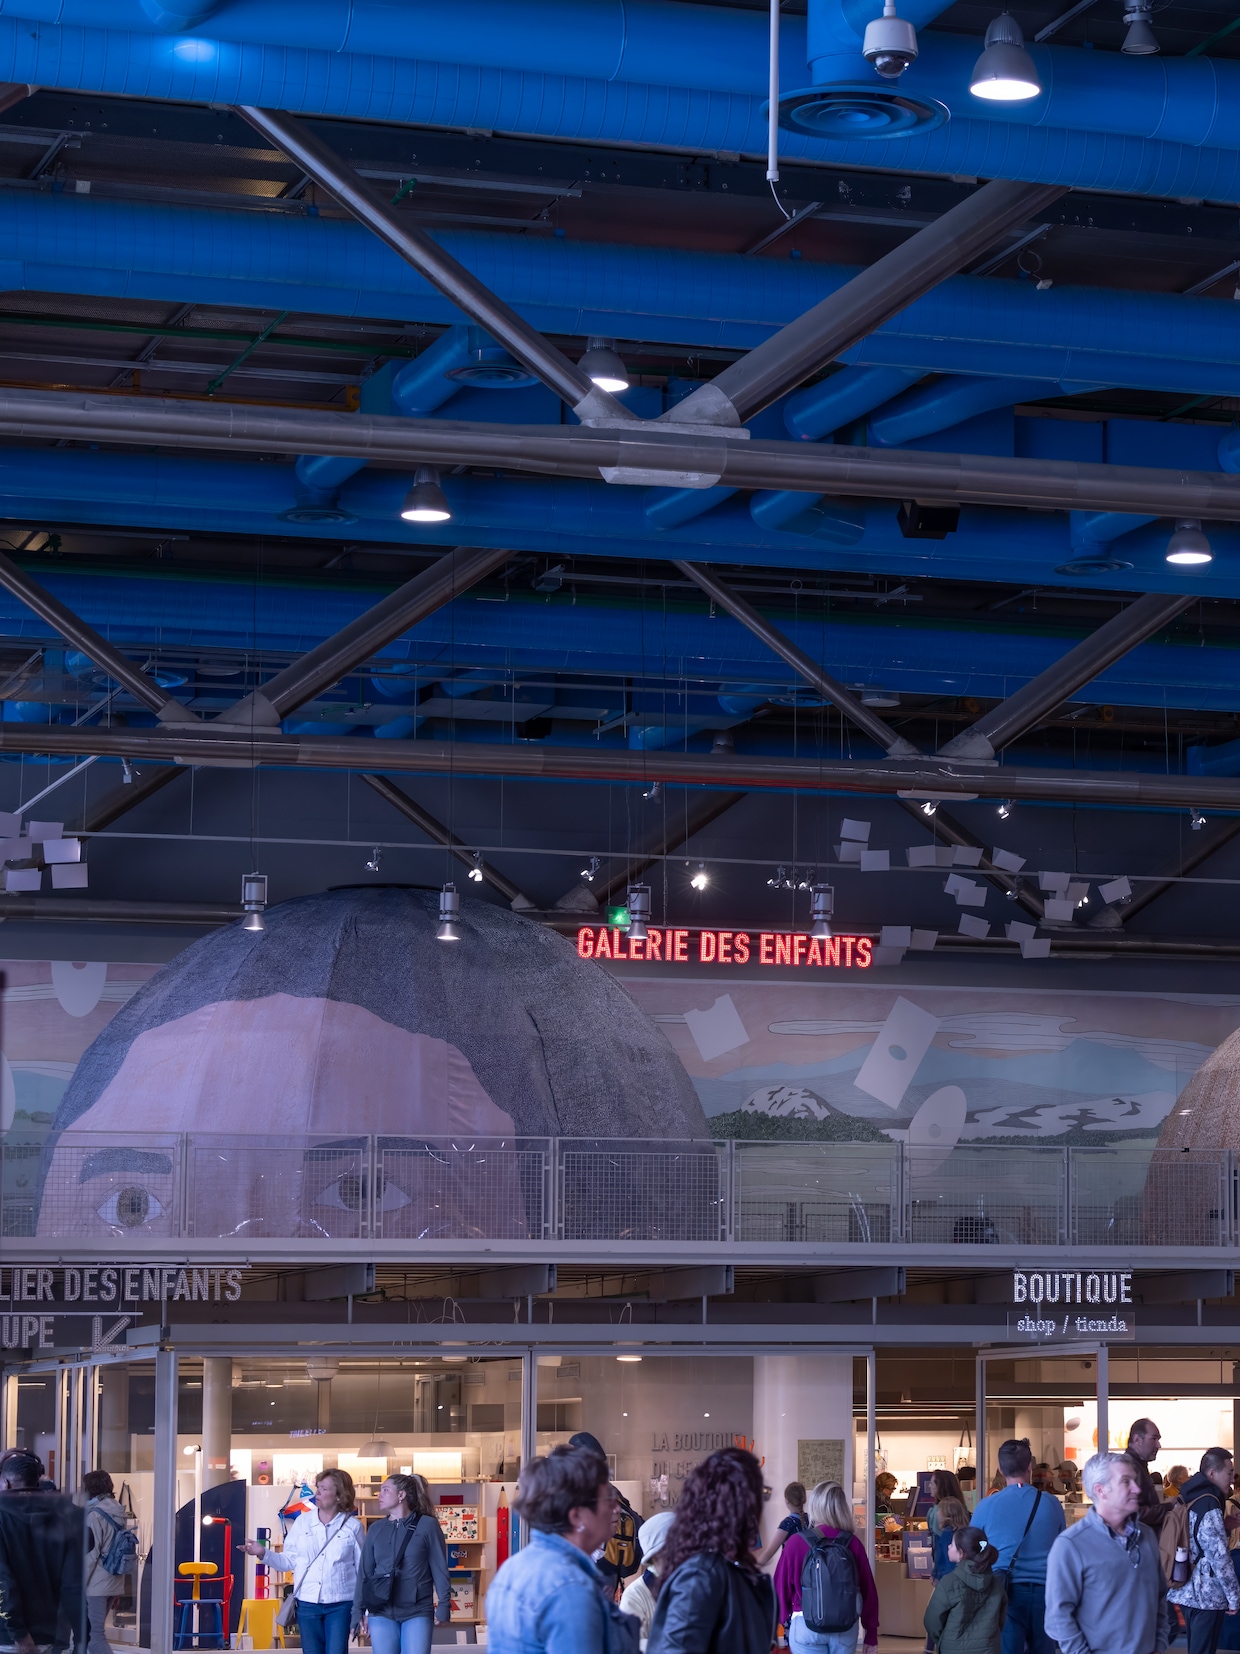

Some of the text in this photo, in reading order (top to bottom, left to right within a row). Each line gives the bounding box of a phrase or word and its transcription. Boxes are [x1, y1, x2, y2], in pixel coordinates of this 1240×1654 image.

[576, 927, 873, 969] GALERIE DES ENFANTS
[0, 1268, 243, 1301] LIER DES ENFANTS
[1013, 1273, 1133, 1303] BOUTIQUE
[2, 1316, 55, 1348] UPE
[1017, 1315, 1128, 1336] shop / tienda
[651, 1432, 669, 1451] LA
